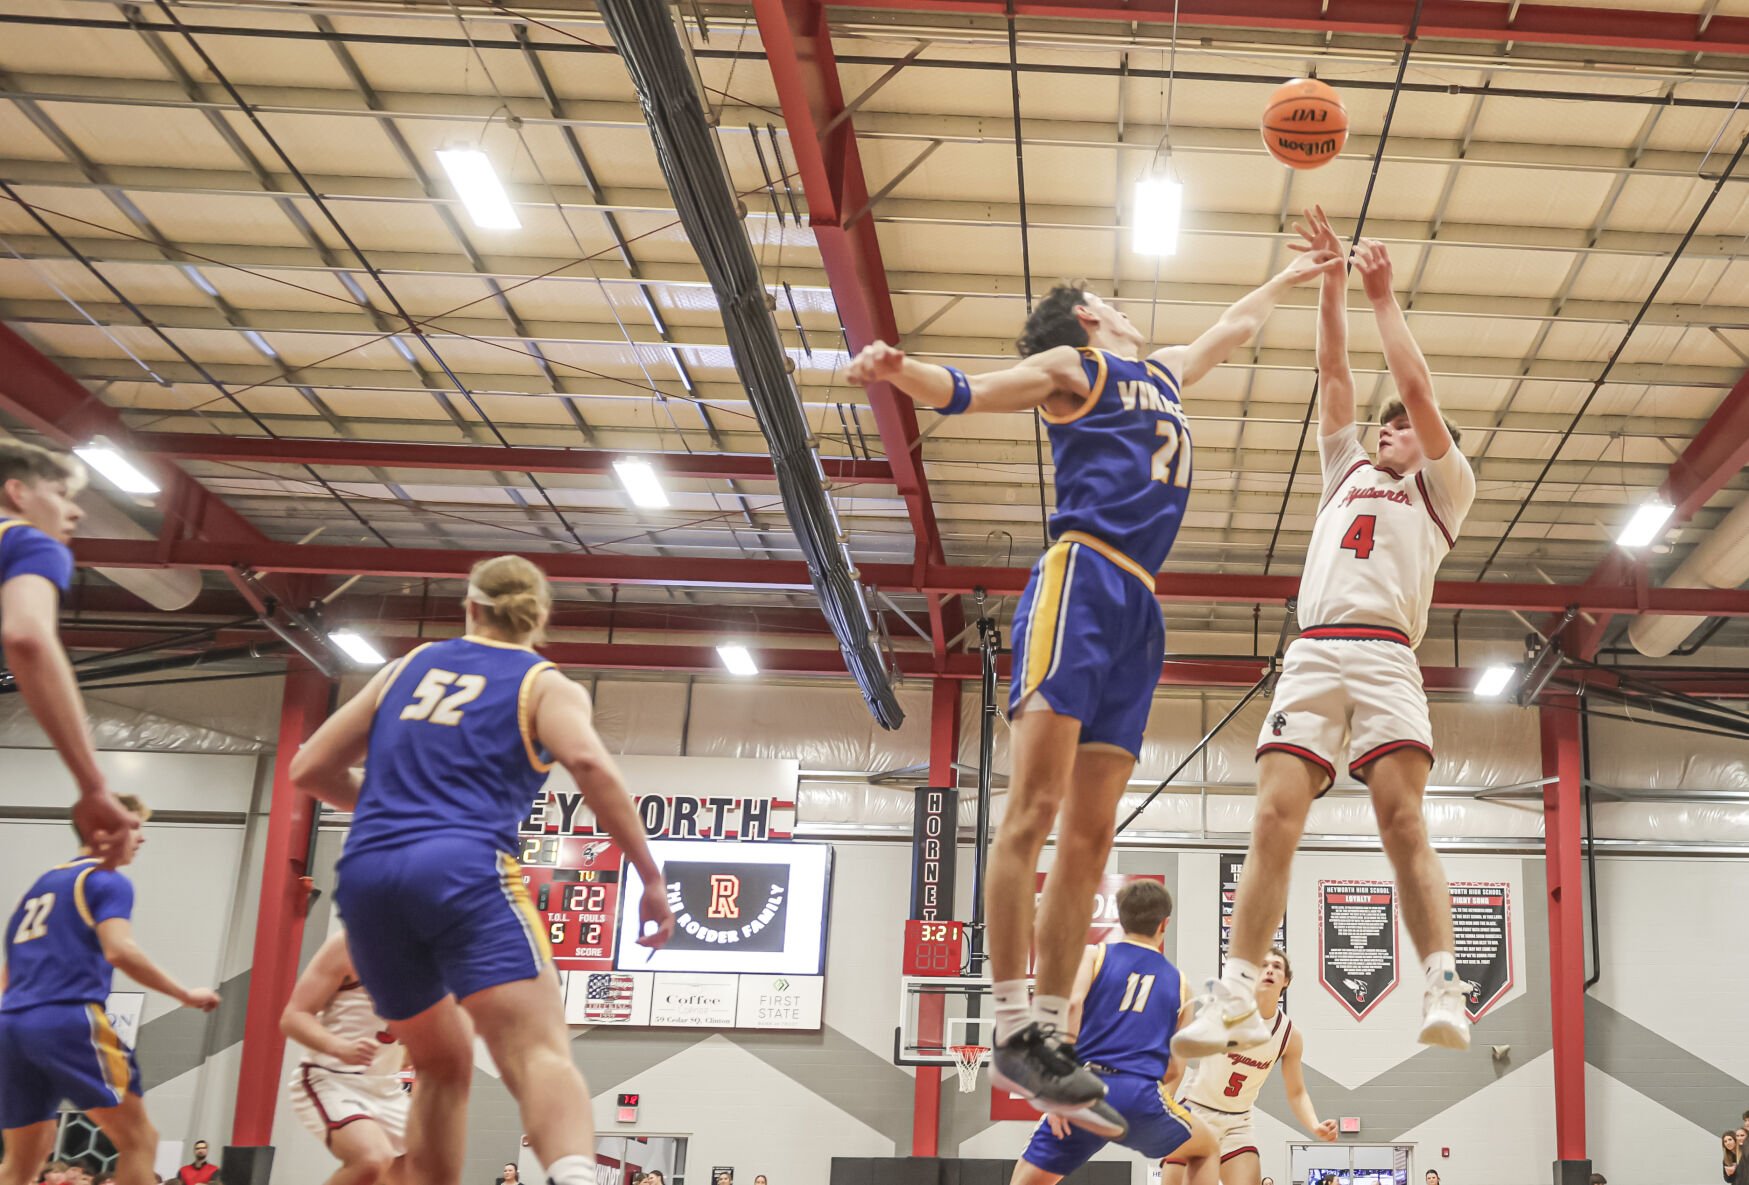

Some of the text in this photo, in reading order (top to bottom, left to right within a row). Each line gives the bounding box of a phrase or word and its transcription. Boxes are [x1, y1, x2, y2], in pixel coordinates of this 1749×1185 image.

[1278, 136, 1336, 156] Wilson
[1151, 420, 1192, 488] 21
[1340, 514, 1377, 559] 4
[400, 667, 487, 726] 52
[518, 790, 771, 841] EYORTH
[579, 871, 595, 882] TV
[570, 886, 606, 911] 22
[708, 874, 740, 918] R
[1326, 886, 1355, 894] HEYWORTH
[1370, 887, 1390, 895] SCHOOL
[1345, 895, 1371, 903] LOYALTY
[13, 892, 55, 944] 22
[578, 914, 606, 922] FOULS
[741, 884, 784, 938] FAMILY
[551, 923, 564, 943] 5
[586, 924, 601, 944] 2
[921, 925, 957, 941] 3:21
[576, 947, 603, 957] SCORE
[666, 995, 721, 1005] Coffee
[760, 995, 801, 1007] FIRST
[1119, 973, 1156, 1013] 11
[758, 1008, 801, 1020] STATE
[1223, 1071, 1248, 1098] 5
